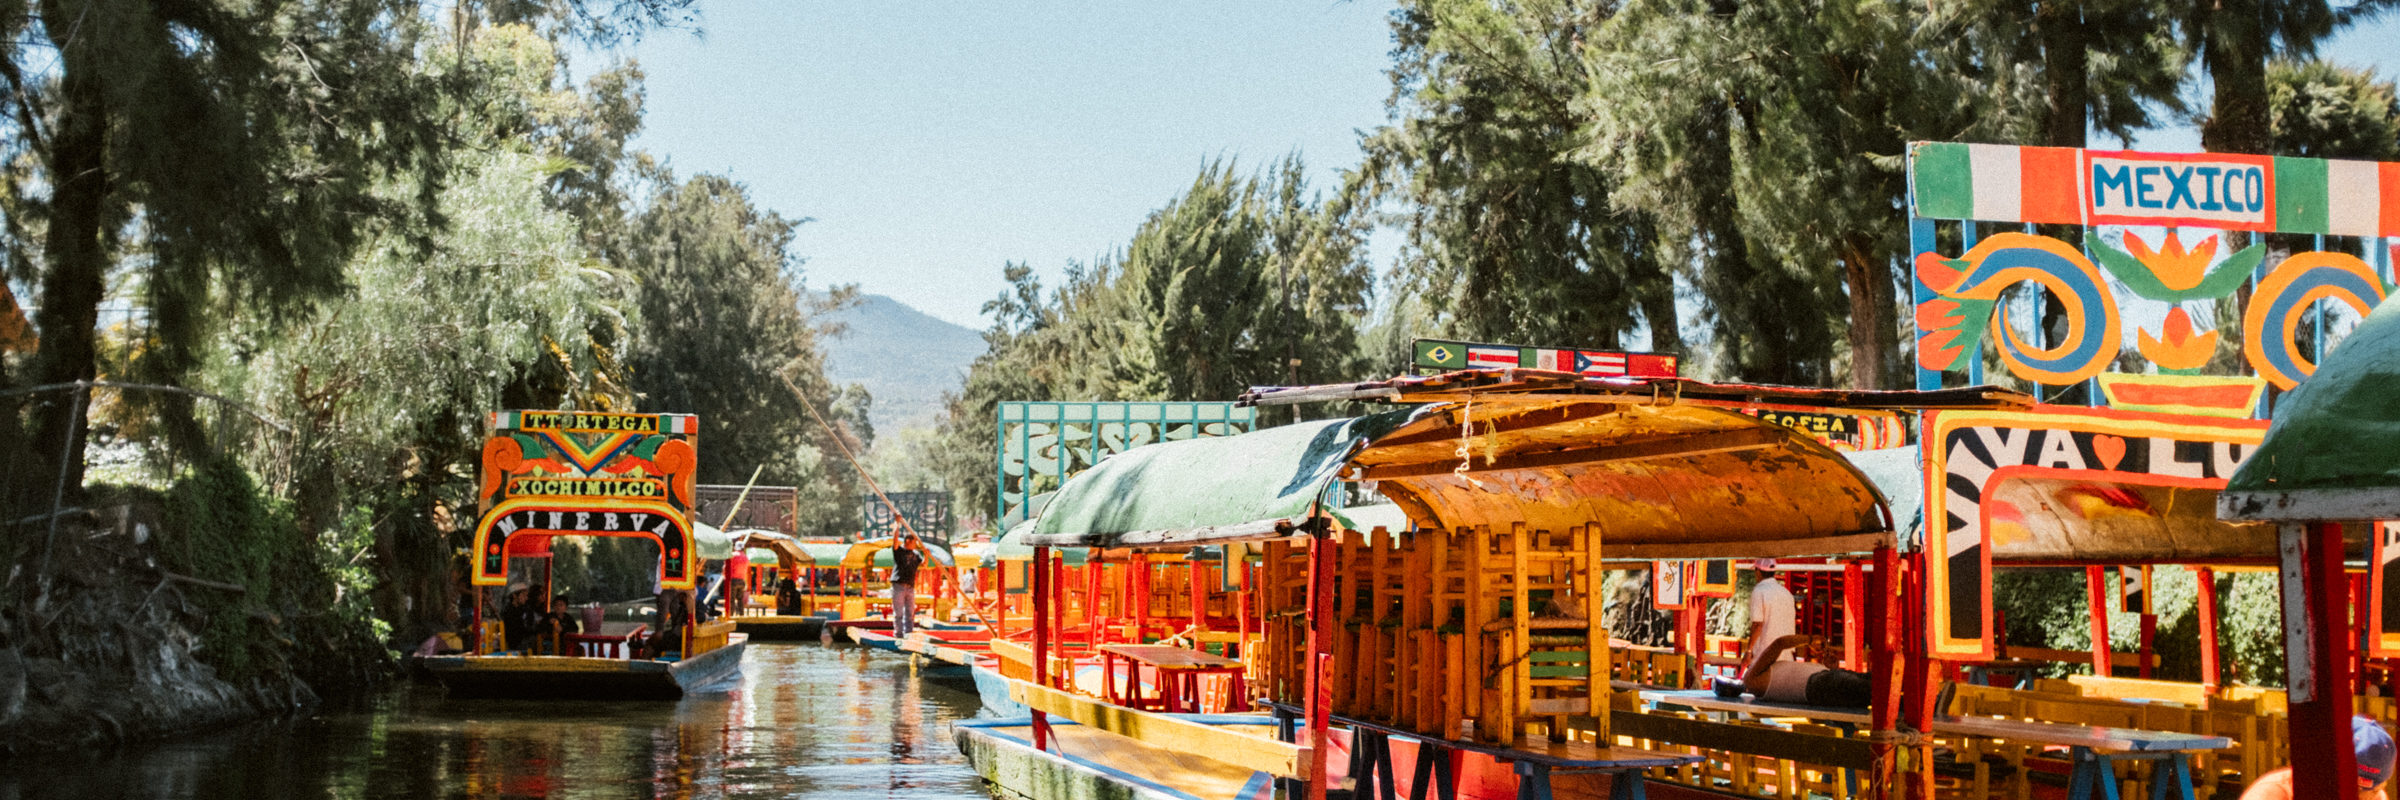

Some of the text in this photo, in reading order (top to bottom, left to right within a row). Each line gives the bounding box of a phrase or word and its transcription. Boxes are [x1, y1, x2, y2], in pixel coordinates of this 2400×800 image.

[2093, 163, 2264, 213] MEXICO
[517, 480, 655, 496] XOCHIMILCO
[497, 511, 669, 537] MINERVA
